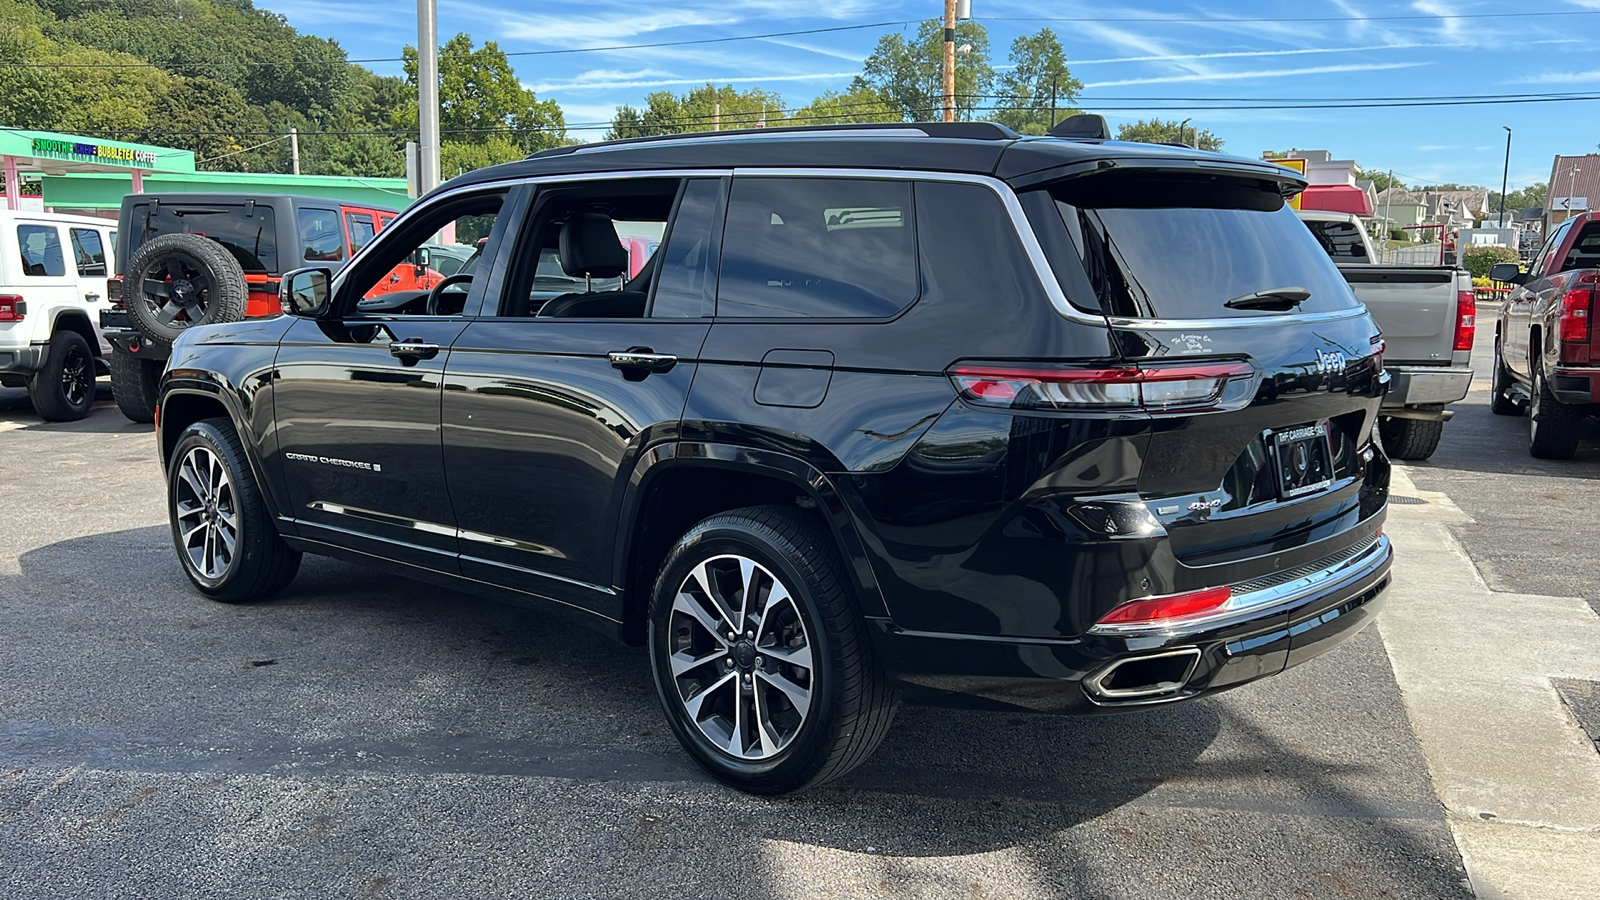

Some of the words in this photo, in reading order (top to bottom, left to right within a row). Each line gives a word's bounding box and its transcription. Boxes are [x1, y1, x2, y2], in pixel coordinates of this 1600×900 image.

[135, 150, 158, 164] COFFEE
[1315, 348, 1346, 375] Jeep
[1289, 426, 1315, 440] CARRIAGE
[285, 452, 318, 463] GRAND
[319, 456, 372, 470] CHEROKEE
